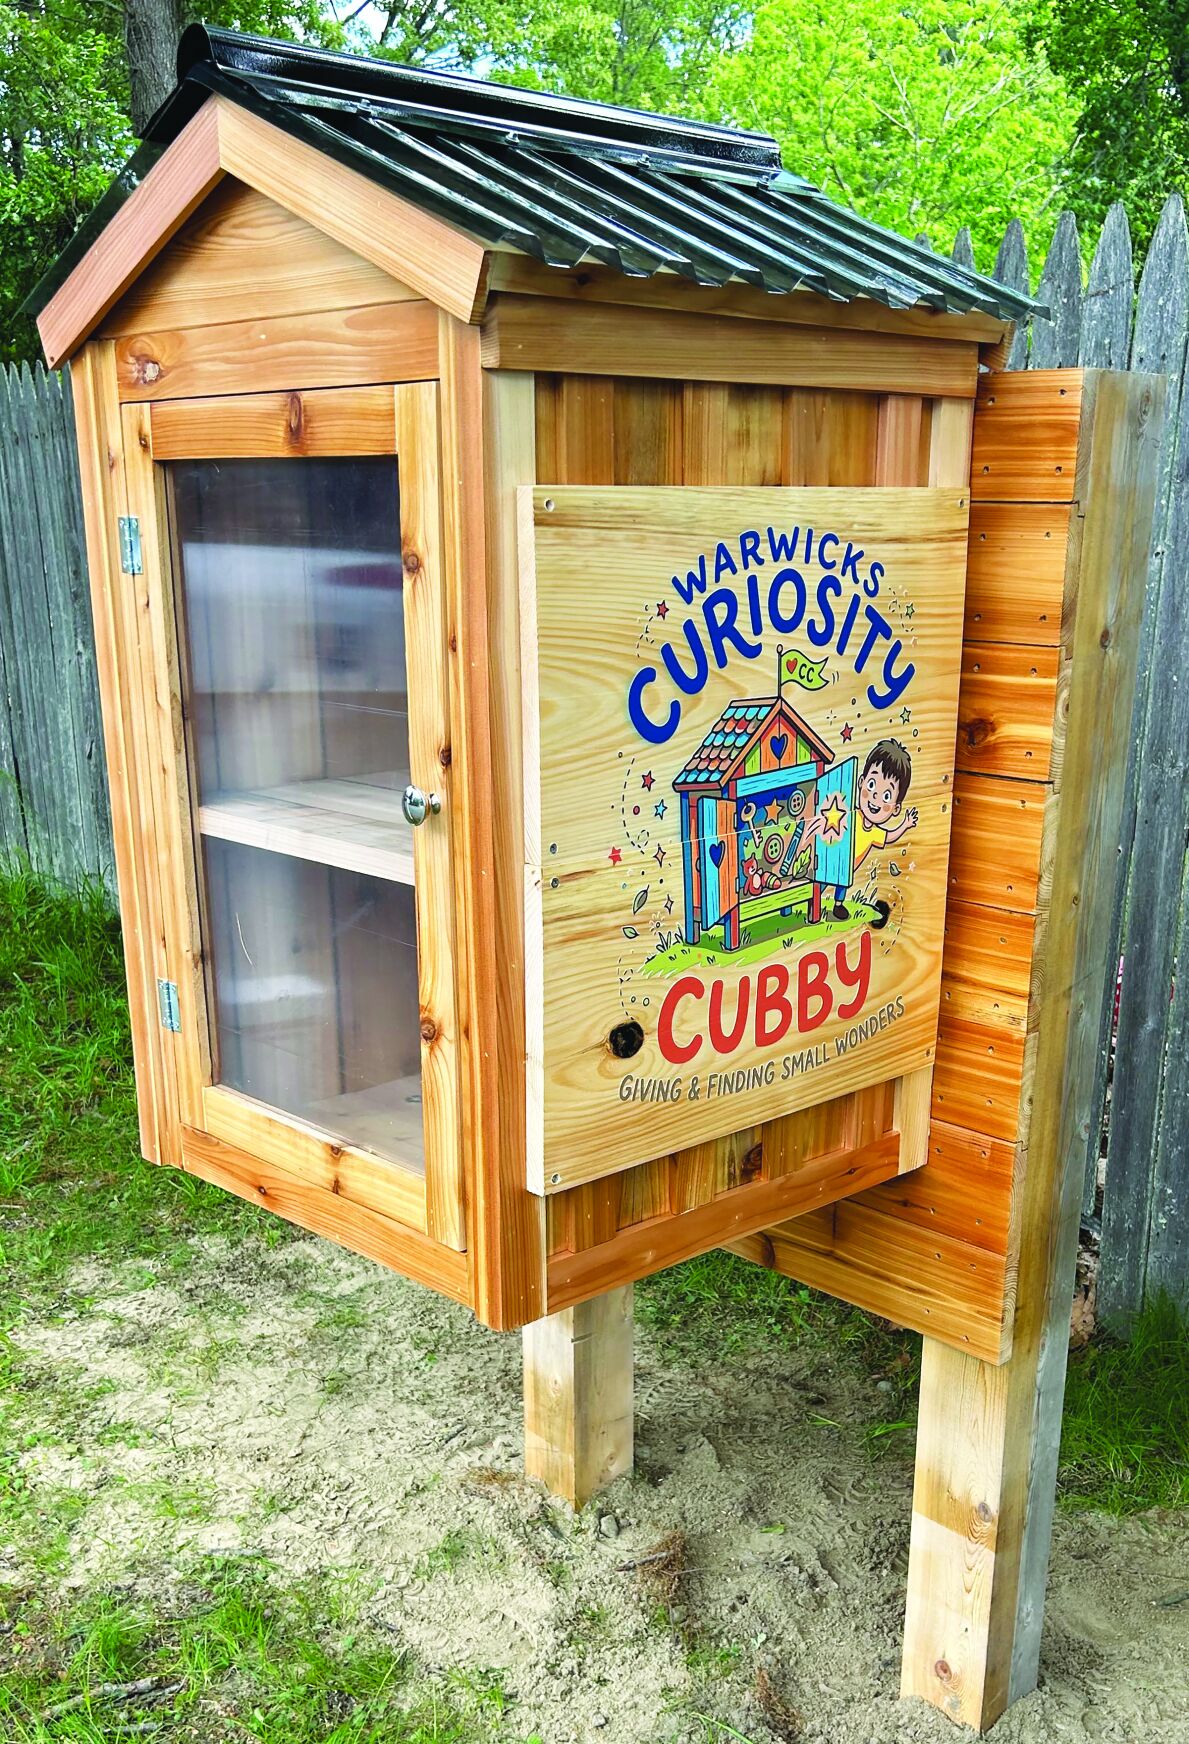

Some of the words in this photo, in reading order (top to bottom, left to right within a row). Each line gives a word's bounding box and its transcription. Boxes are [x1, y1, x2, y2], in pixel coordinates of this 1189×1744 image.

[671, 526, 885, 605] WARWICKS
[628, 568, 916, 743] CURIOSITY
[798, 663, 815, 684] CC
[619, 1074, 682, 1103] GIVING
[687, 1077, 701, 1101] &
[707, 1061, 775, 1100] FINDING
[781, 1043, 830, 1080] SMALL
[835, 995, 905, 1057] WONDERS
[657, 930, 872, 1065] CUBBY
